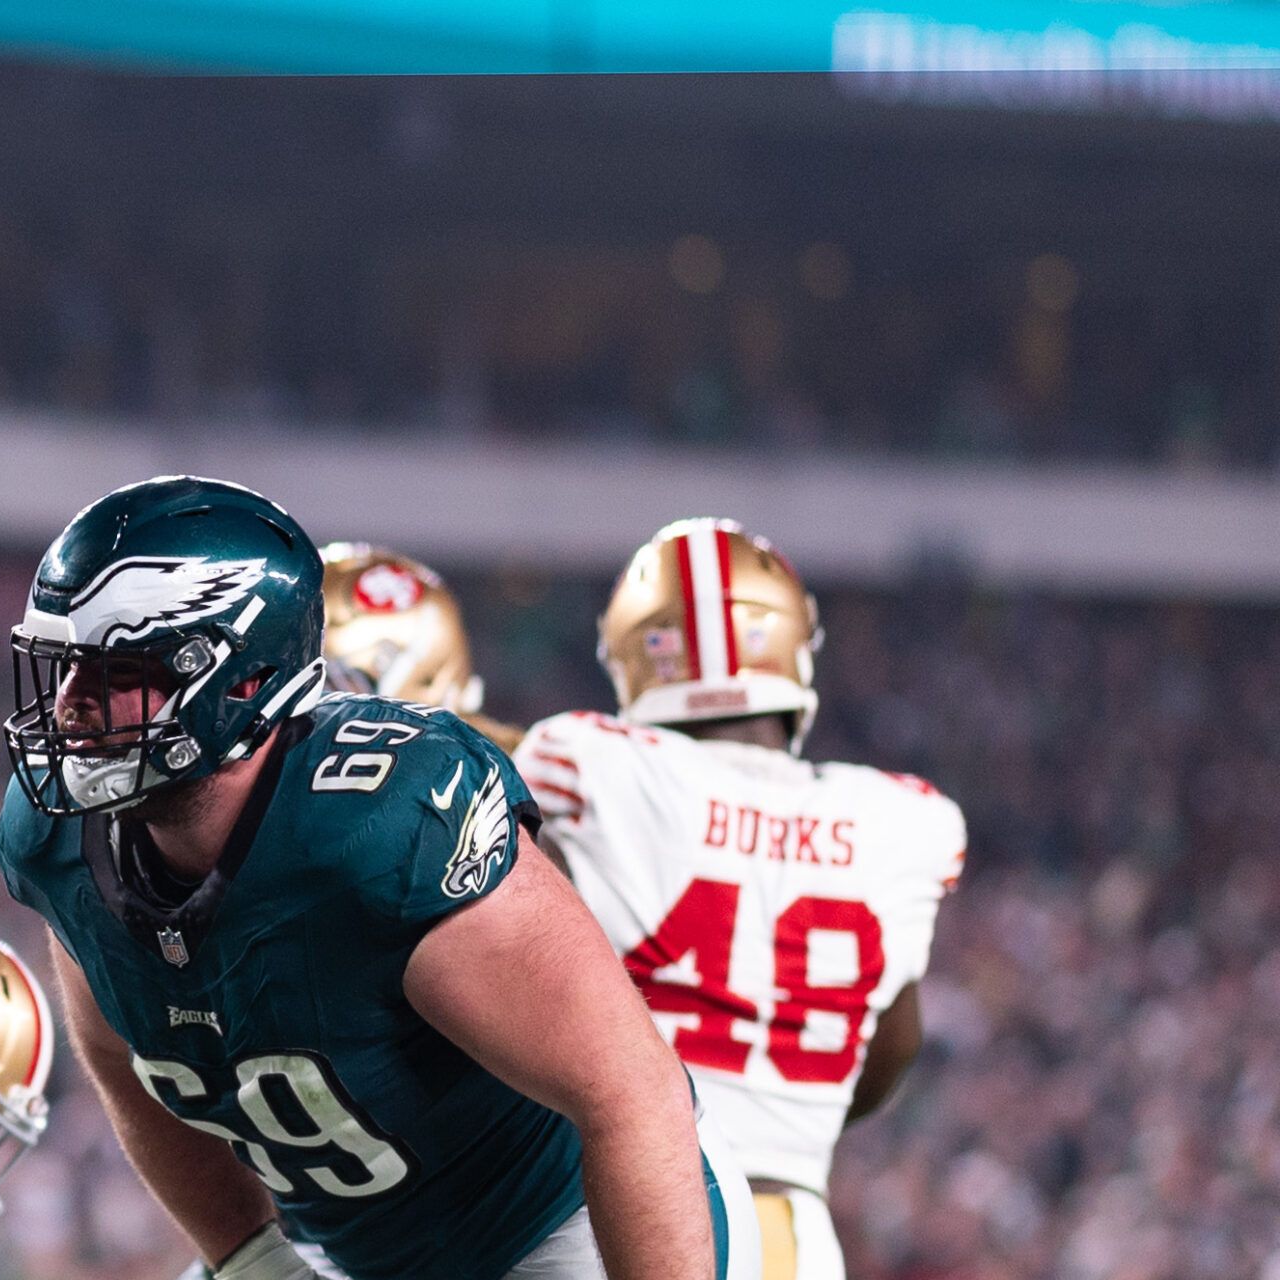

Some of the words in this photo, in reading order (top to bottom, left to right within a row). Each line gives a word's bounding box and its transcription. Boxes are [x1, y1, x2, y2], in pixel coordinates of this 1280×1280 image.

[312, 719, 425, 792] 69
[703, 799, 855, 867] BURKS
[622, 877, 885, 1084] 48
[167, 1005, 223, 1037] EAGLES
[131, 1053, 409, 1198] 69
